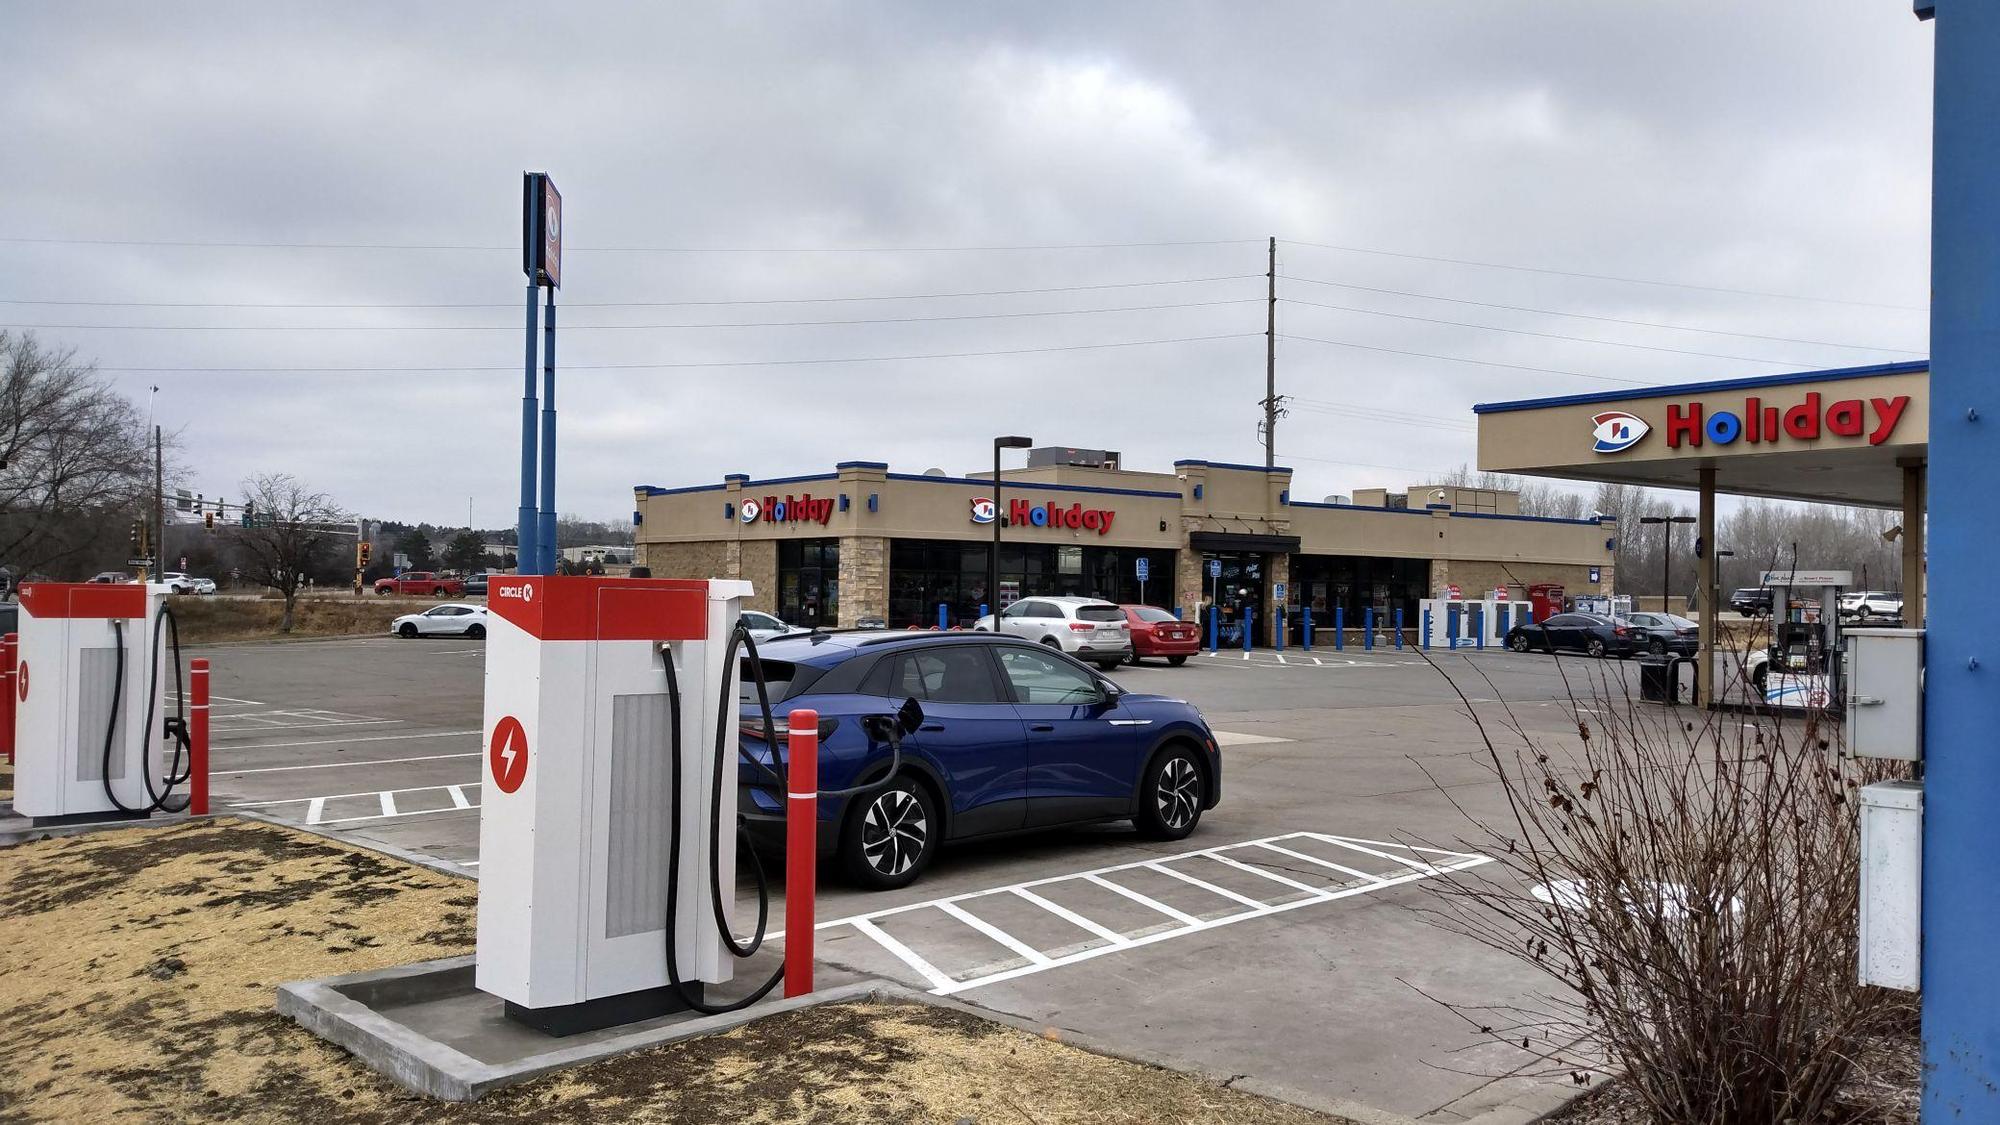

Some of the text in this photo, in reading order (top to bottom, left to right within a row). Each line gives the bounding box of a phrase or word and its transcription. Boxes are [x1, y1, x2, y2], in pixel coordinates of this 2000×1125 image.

[1667, 392, 1911, 448] Holiday
[763, 494, 835, 525] Holiday
[1010, 499, 1115, 535] Holiday
[499, 585, 533, 601] CIRCLE K
